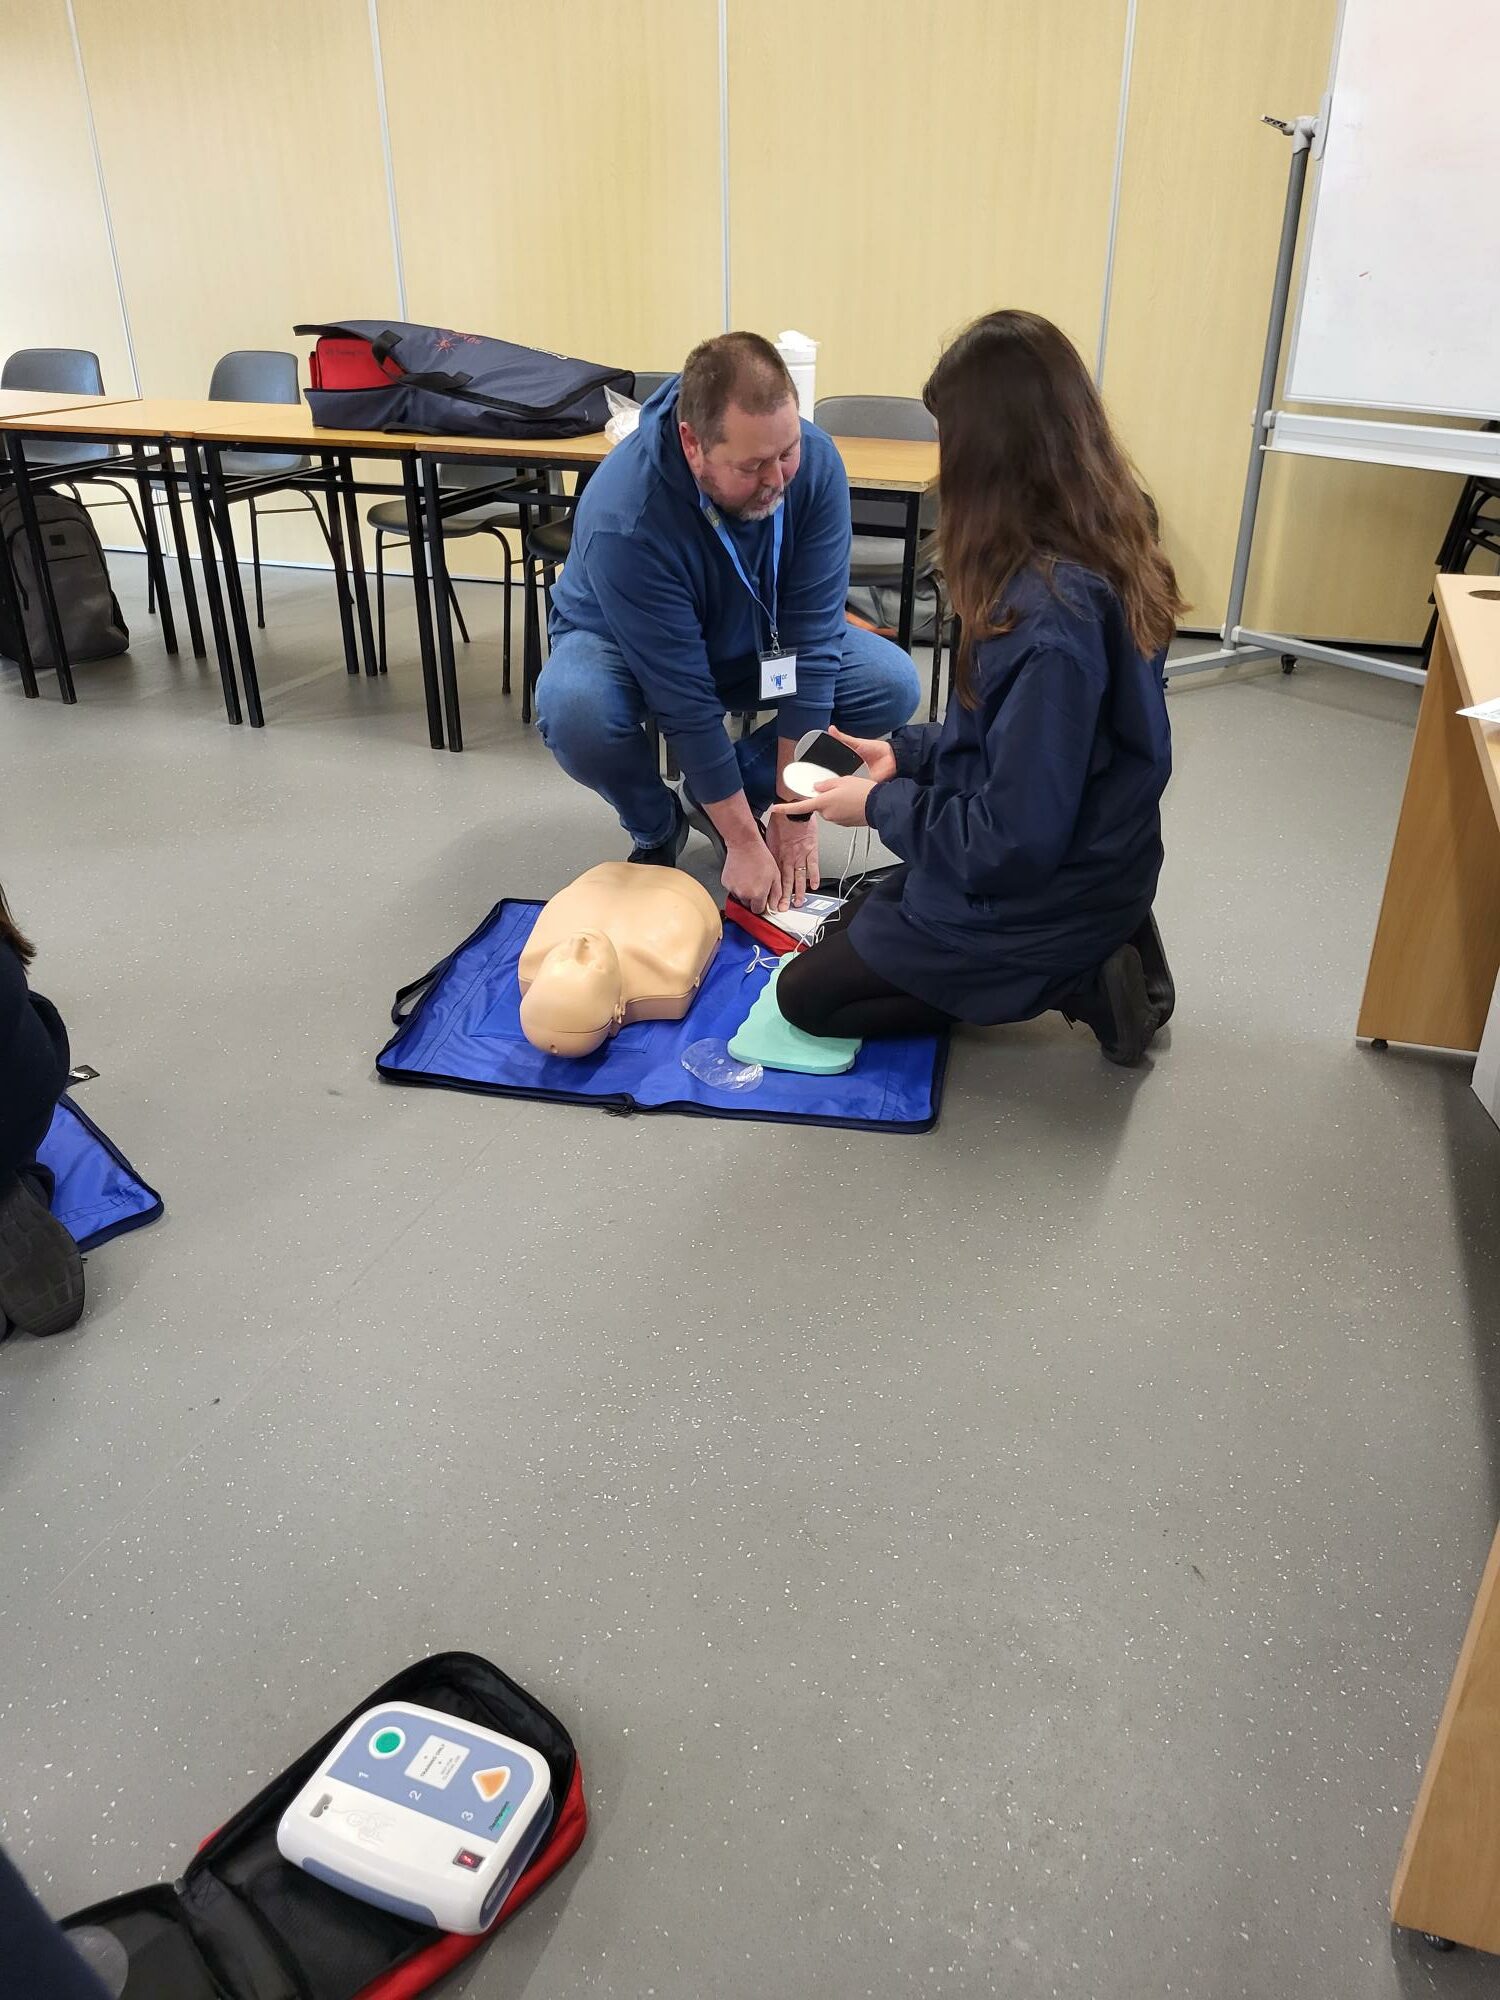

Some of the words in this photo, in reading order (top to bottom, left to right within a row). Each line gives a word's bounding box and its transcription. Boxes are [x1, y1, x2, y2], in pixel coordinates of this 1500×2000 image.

[358, 1771, 369, 1779] 1
[408, 1790, 422, 1801] 2
[461, 1810, 474, 1822] 3
